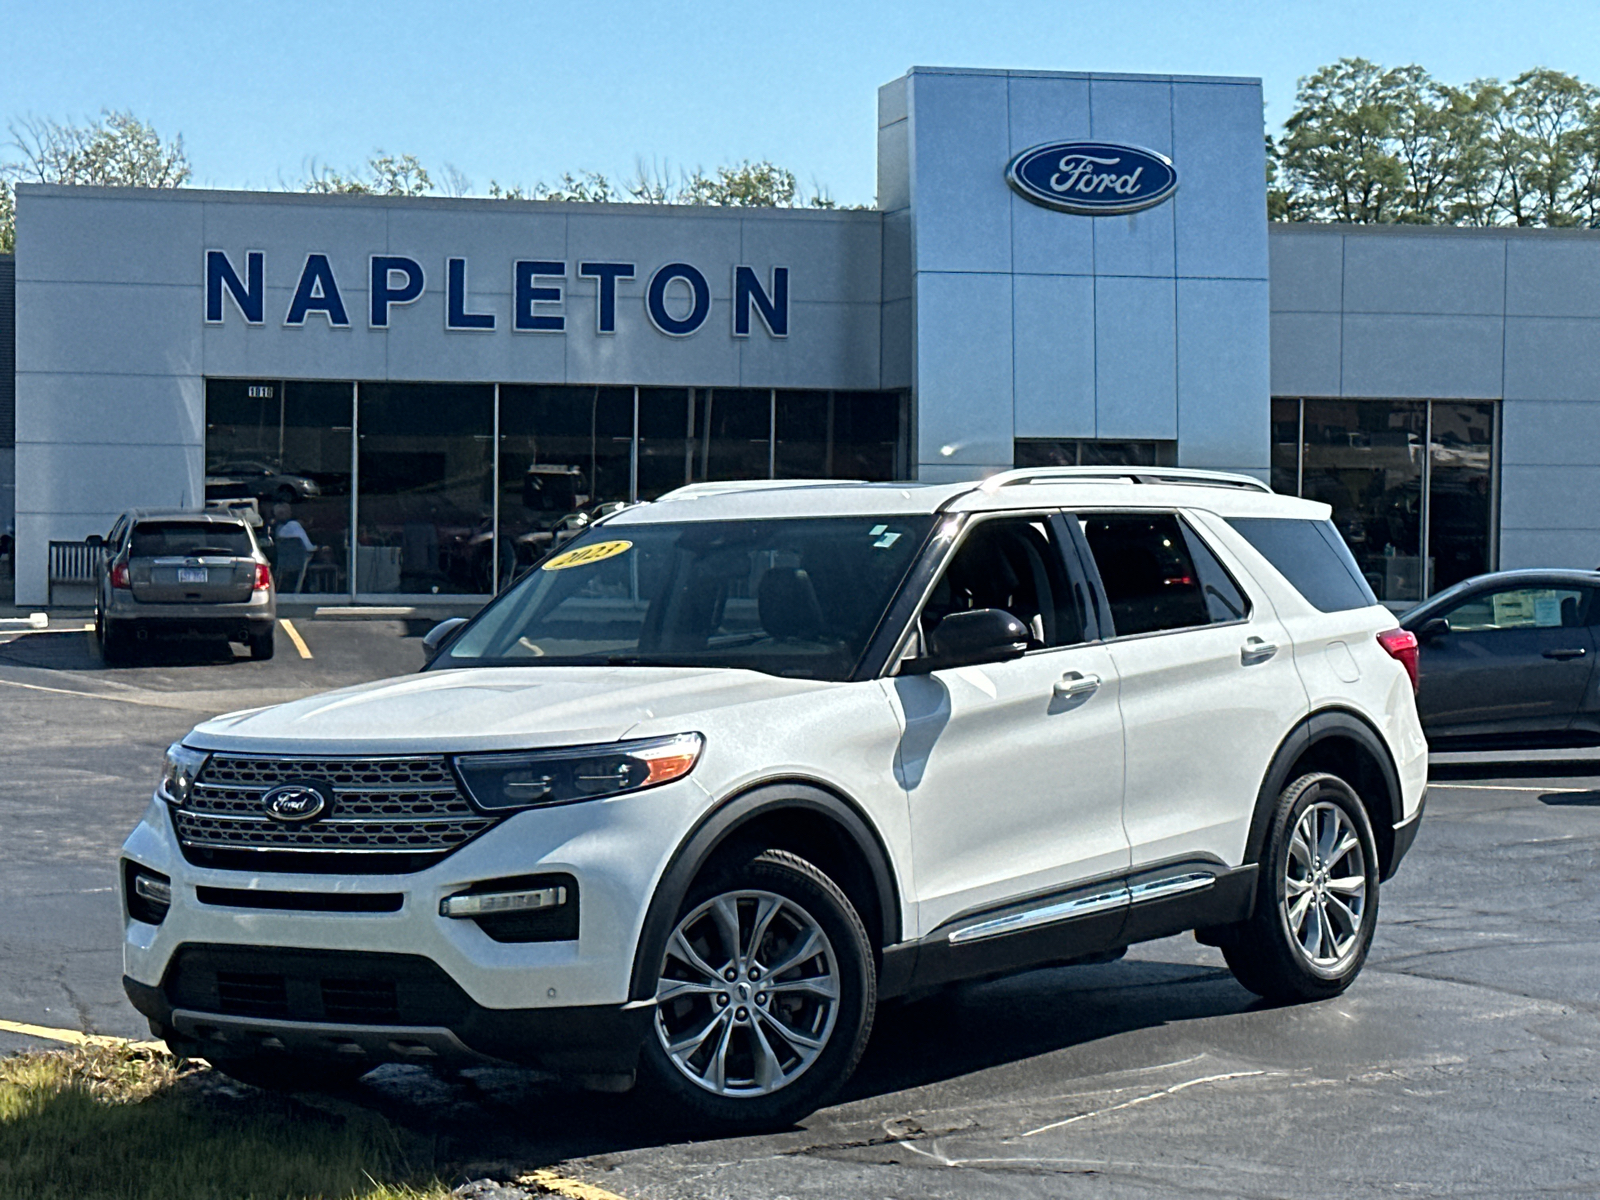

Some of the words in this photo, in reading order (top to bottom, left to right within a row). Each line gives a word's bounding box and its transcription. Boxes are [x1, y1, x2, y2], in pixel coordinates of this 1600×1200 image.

[1050, 155, 1144, 195] Ford
[204, 249, 790, 338] NAPLETON
[273, 792, 309, 812] Ford
